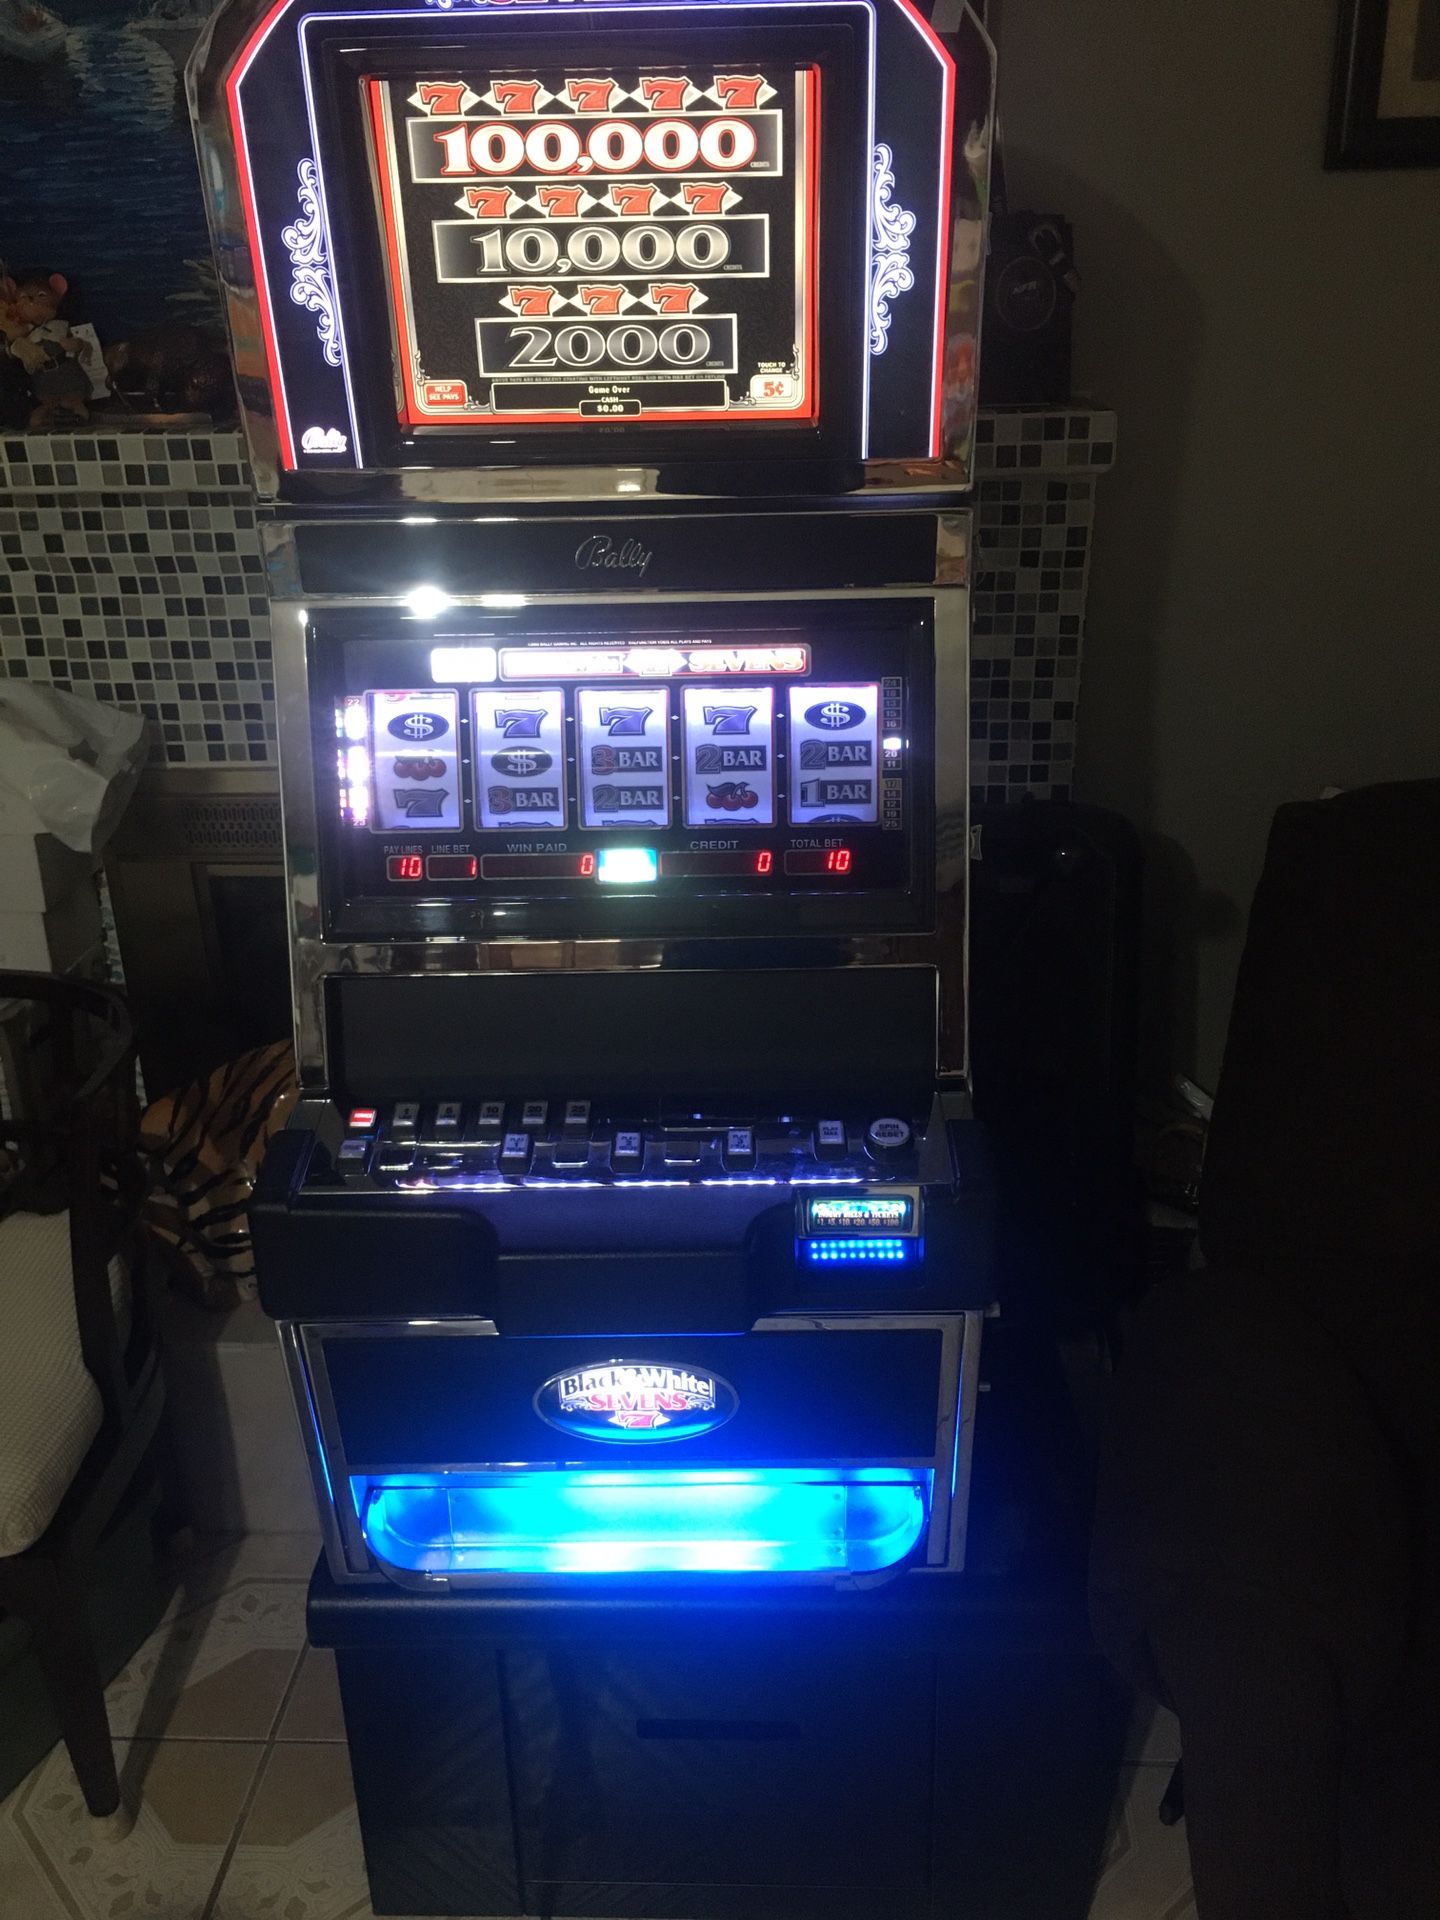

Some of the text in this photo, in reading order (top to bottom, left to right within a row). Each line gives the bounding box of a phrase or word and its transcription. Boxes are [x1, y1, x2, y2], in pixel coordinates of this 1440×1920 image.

[418, 75, 764, 115] 7 7 7 7 7
[433, 116, 758, 175] 100,000
[466, 183, 730, 219] 7 7 7 7
[471, 224, 730, 274] 10,000
[510, 284, 697, 316] 7 7 7
[508, 323, 711, 367] 2000
[588, 385, 630, 394] Game Over
[763, 381, 784, 397] 5¢
[597, 404, 624, 413] $0.00
[575, 535, 653, 577] Bally
[494, 707, 549, 738] 7
[599, 706, 654, 736] 7
[703, 705, 758, 735] 7
[393, 788, 450, 818] 7
[384, 845, 423, 854] PAY LINES
[431, 844, 470, 854] LINE BET
[507, 843, 567, 853] WIN PAID
[690, 840, 739, 849] CREDIT
[790, 838, 844, 848] TOTAL BET
[400, 856, 422, 877] 10
[580, 854, 594, 875] 0
[757, 852, 772, 872] 0
[827, 850, 850, 871] 10
[645, 1368, 711, 1394] White
[590, 1391, 688, 1411] SEVENS
[615, 1410, 661, 1429] 7
